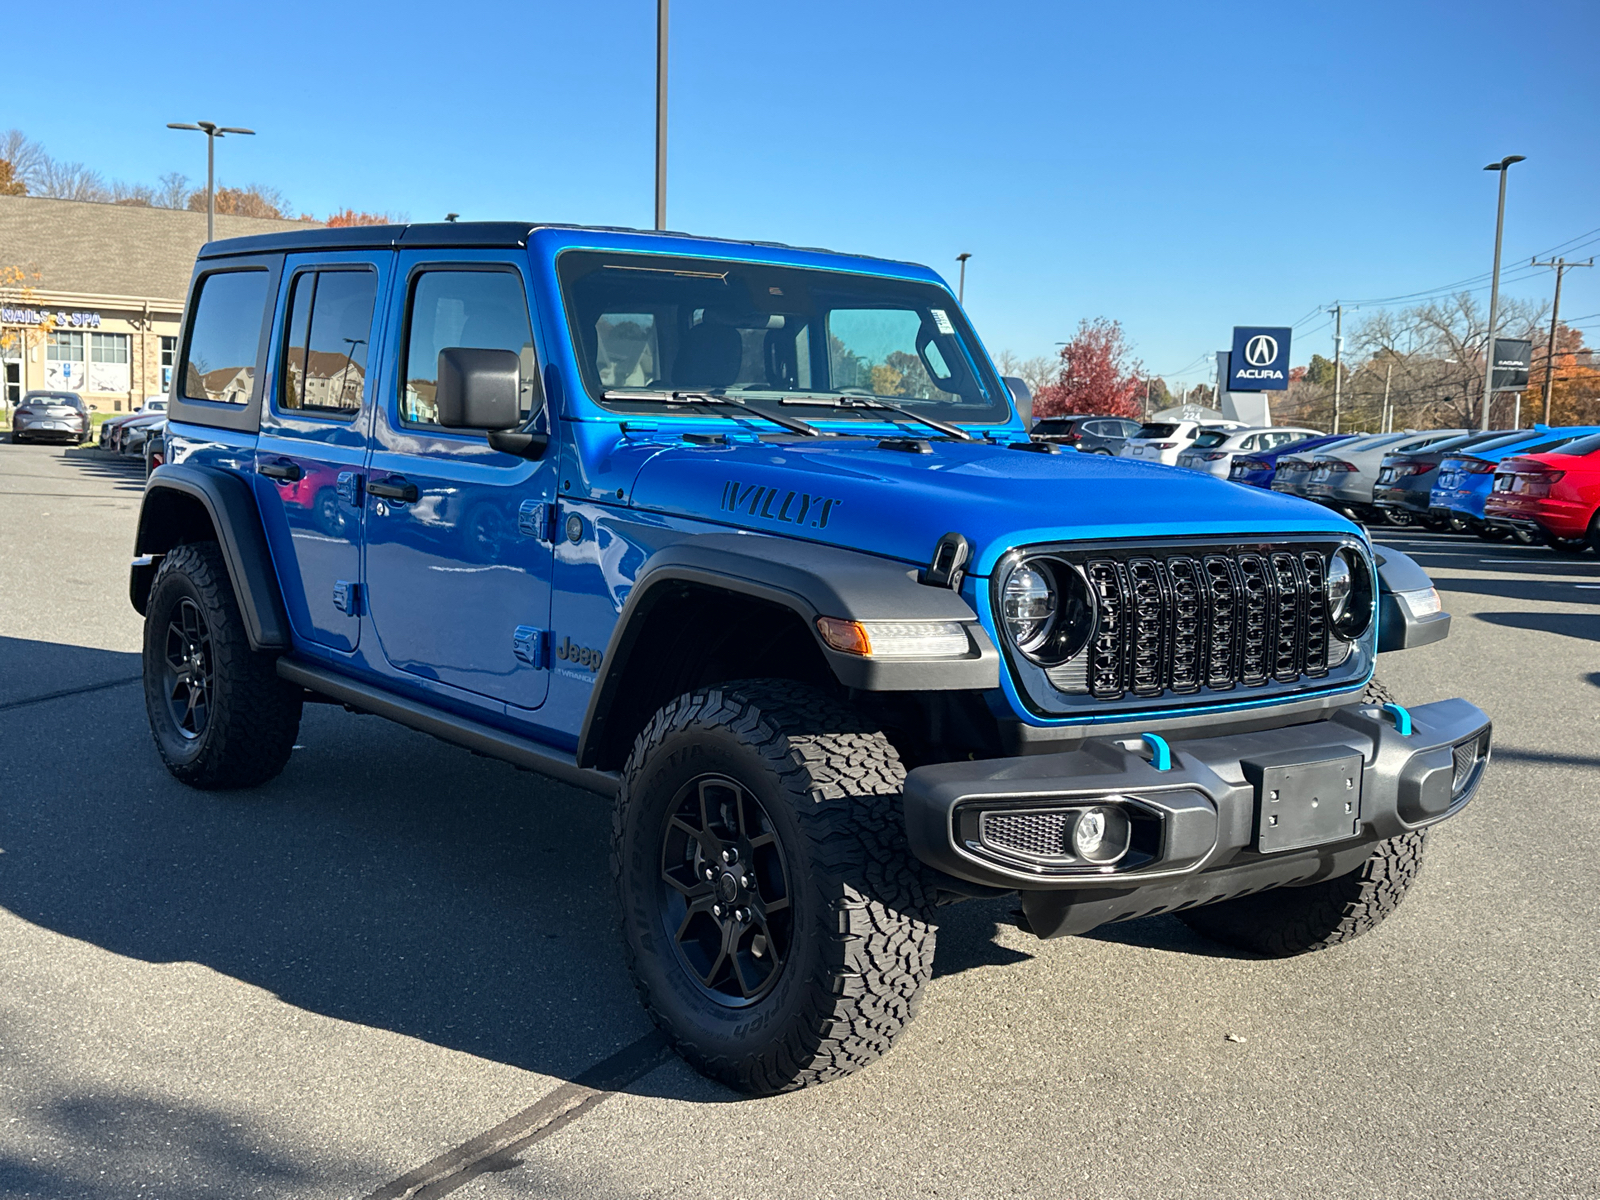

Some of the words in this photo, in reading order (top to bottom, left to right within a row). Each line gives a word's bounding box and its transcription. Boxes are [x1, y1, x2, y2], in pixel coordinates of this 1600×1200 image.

[1, 307, 50, 324] NAILS
[57, 310, 67, 325] &
[71, 311, 101, 326] SPA
[1236, 369, 1284, 379] ACURA
[1183, 412, 1201, 420] 224
[720, 480, 843, 530] WILLYS
[556, 636, 603, 673] Jeep
[561, 669, 597, 684] WRANGL
